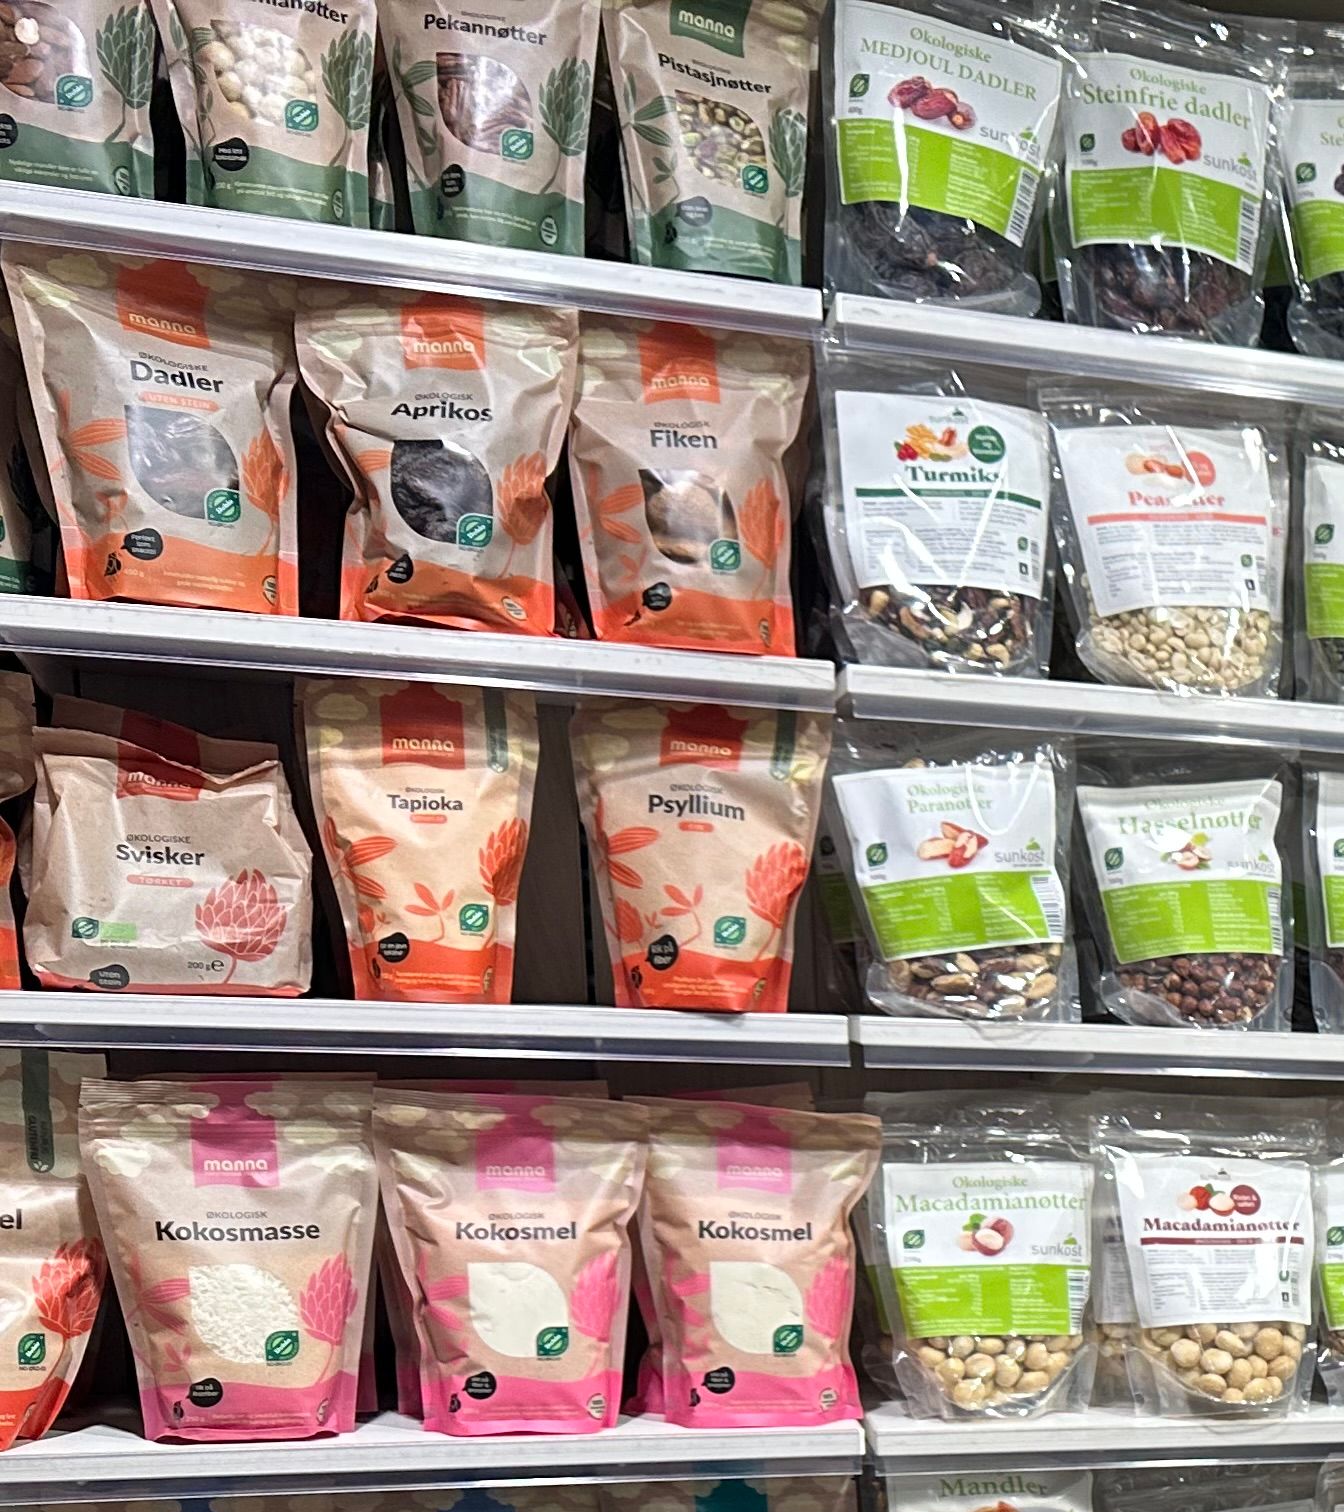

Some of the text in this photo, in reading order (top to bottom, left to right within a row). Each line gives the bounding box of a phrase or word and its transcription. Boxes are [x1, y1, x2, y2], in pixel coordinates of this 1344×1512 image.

[424, 13, 547, 46] Pekannøtter
[678, 9, 735, 38] manna
[910, 27, 992, 64] Økologiske
[657, 53, 772, 94] Pistasjnøtter
[860, 38, 1037, 102] MEDJOUL DADLER
[1130, 68, 1206, 96] Økologiske
[1083, 83, 1251, 130] Steinfrie dadler
[129, 311, 198, 336] manna
[413, 338, 475, 355] manna
[130, 359, 224, 394] Dadler
[415, 391, 473, 402] ØKOLOGISK
[391, 400, 493, 423] Aprikos
[650, 429, 718, 450] Fiken
[393, 737, 455, 753] manna
[670, 739, 732, 756] manna
[387, 793, 463, 814] Tapioka
[648, 793, 745, 821] Psyllium
[127, 834, 191, 844] ØKOLOGISKE
[116, 842, 205, 866] Svisker
[994, 849, 1045, 865] sunkost
[204, 1157, 268, 1172] manna
[486, 1165, 545, 1177] manna
[726, 1166, 783, 1179] manna
[953, 1176, 1029, 1190] Økologiske
[896, 1191, 1086, 1214] Macadamianøtter
[206, 1210, 268, 1220] ØKOLOGISK
[155, 1219, 321, 1243] Kokosmasse
[455, 1220, 577, 1242] Kokosmel
[697, 1220, 813, 1242] Kokosmel
[1031, 1242, 1084, 1259] sunkost
[940, 1474, 1048, 1498] Mandler
